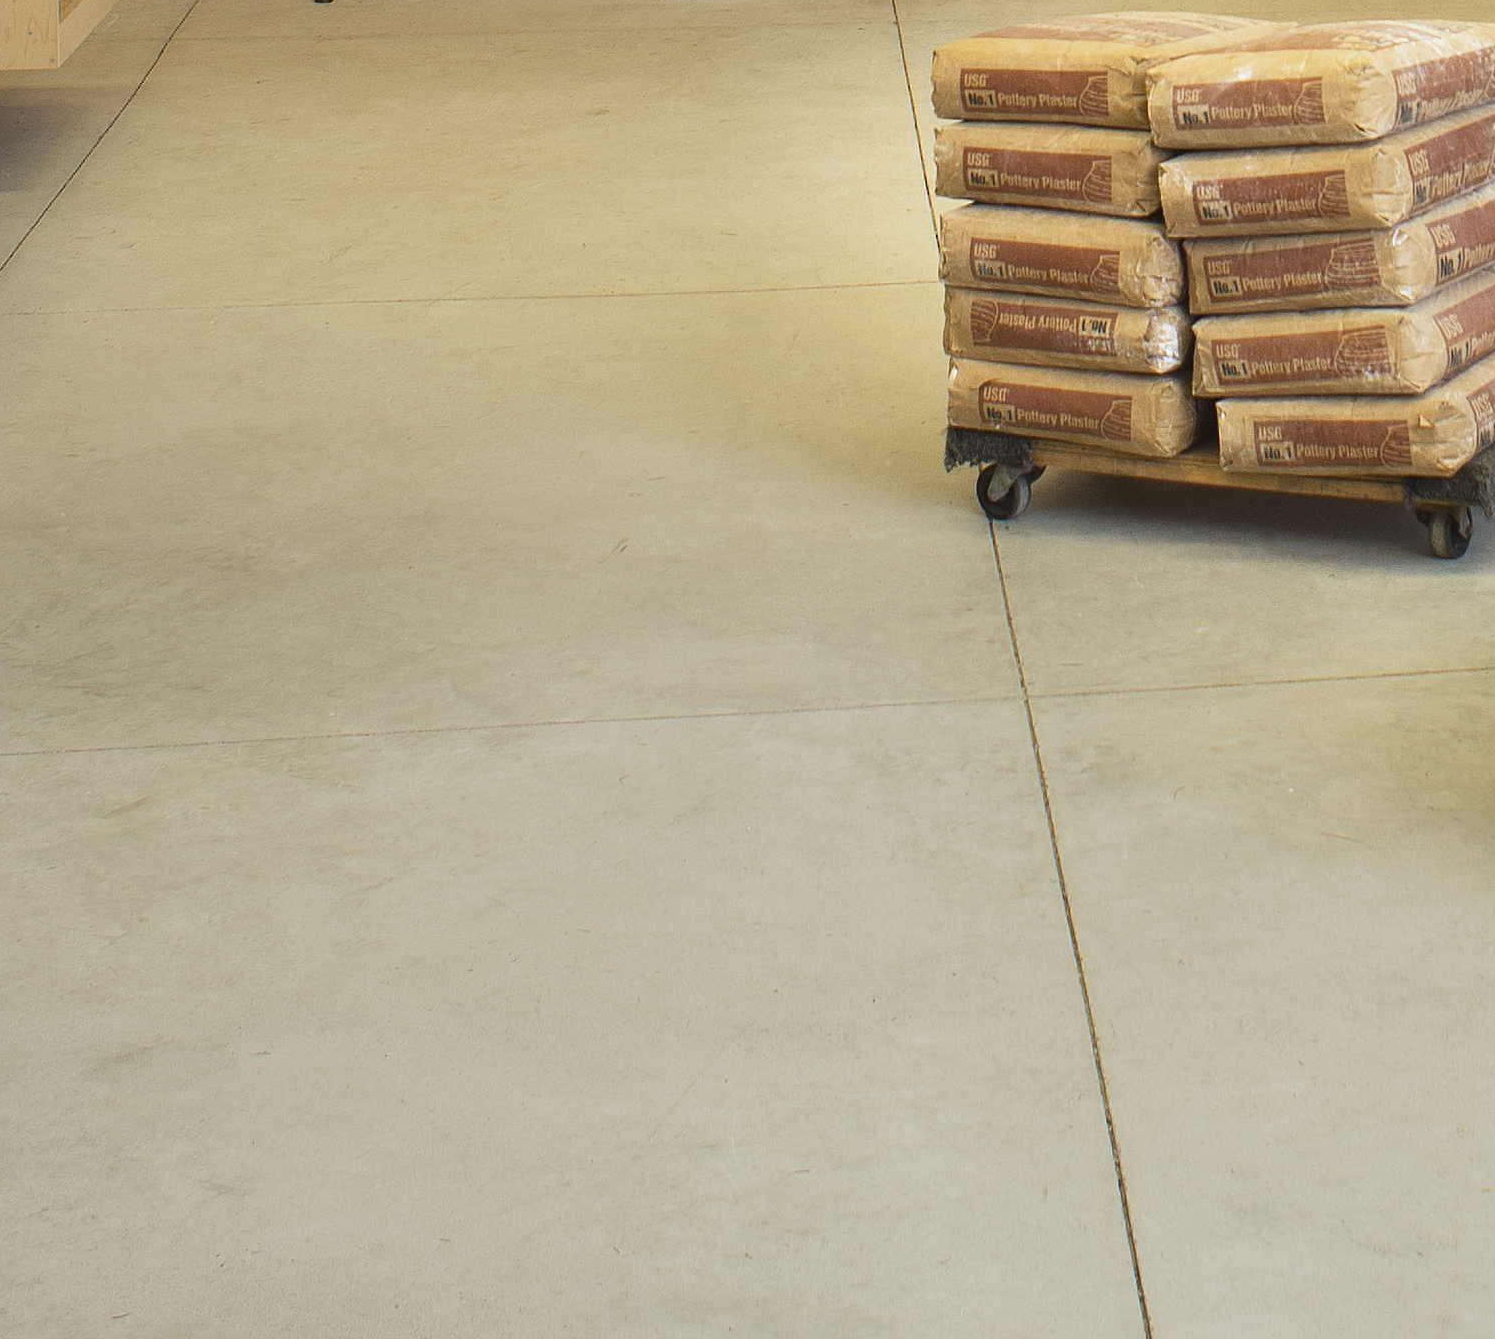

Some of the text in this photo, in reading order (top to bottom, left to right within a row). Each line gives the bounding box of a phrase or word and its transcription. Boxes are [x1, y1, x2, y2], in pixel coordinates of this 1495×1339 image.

[964, 74, 987, 87] USG
[998, 93, 1037, 108] Pottery
[1039, 94, 1077, 107] Plaster
[1177, 88, 1199, 102] USG
[1212, 106, 1252, 121] Pottery
[1255, 103, 1292, 117] Plaster
[967, 152, 989, 165] USG
[1000, 173, 1039, 188] Pottery
[1042, 176, 1081, 191] Plaster
[1196, 186, 1219, 200] USG
[1233, 201, 1274, 216] Pottery
[1277, 198, 1316, 212] Plaster
[974, 244, 997, 258] USG
[1008, 265, 1047, 280] Pottery
[1049, 269, 1089, 284] Plaster
[1207, 261, 1229, 274] USG
[1242, 275, 1281, 290] Pottery
[1283, 272, 1321, 287] Plaster
[1000, 313, 1035, 329] Plaster
[1038, 315, 1077, 333] Pottery
[1216, 344, 1238, 359] USG
[1252, 361, 1290, 374] Pottery
[1292, 358, 1331, 370] Plaster
[983, 387, 1006, 401] USG
[1017, 408, 1056, 424] Pottery
[1060, 413, 1100, 429] Plaster
[1259, 426, 1282, 440] USG
[1296, 444, 1336, 459] Pottery
[1339, 445, 1379, 459] Plaster
